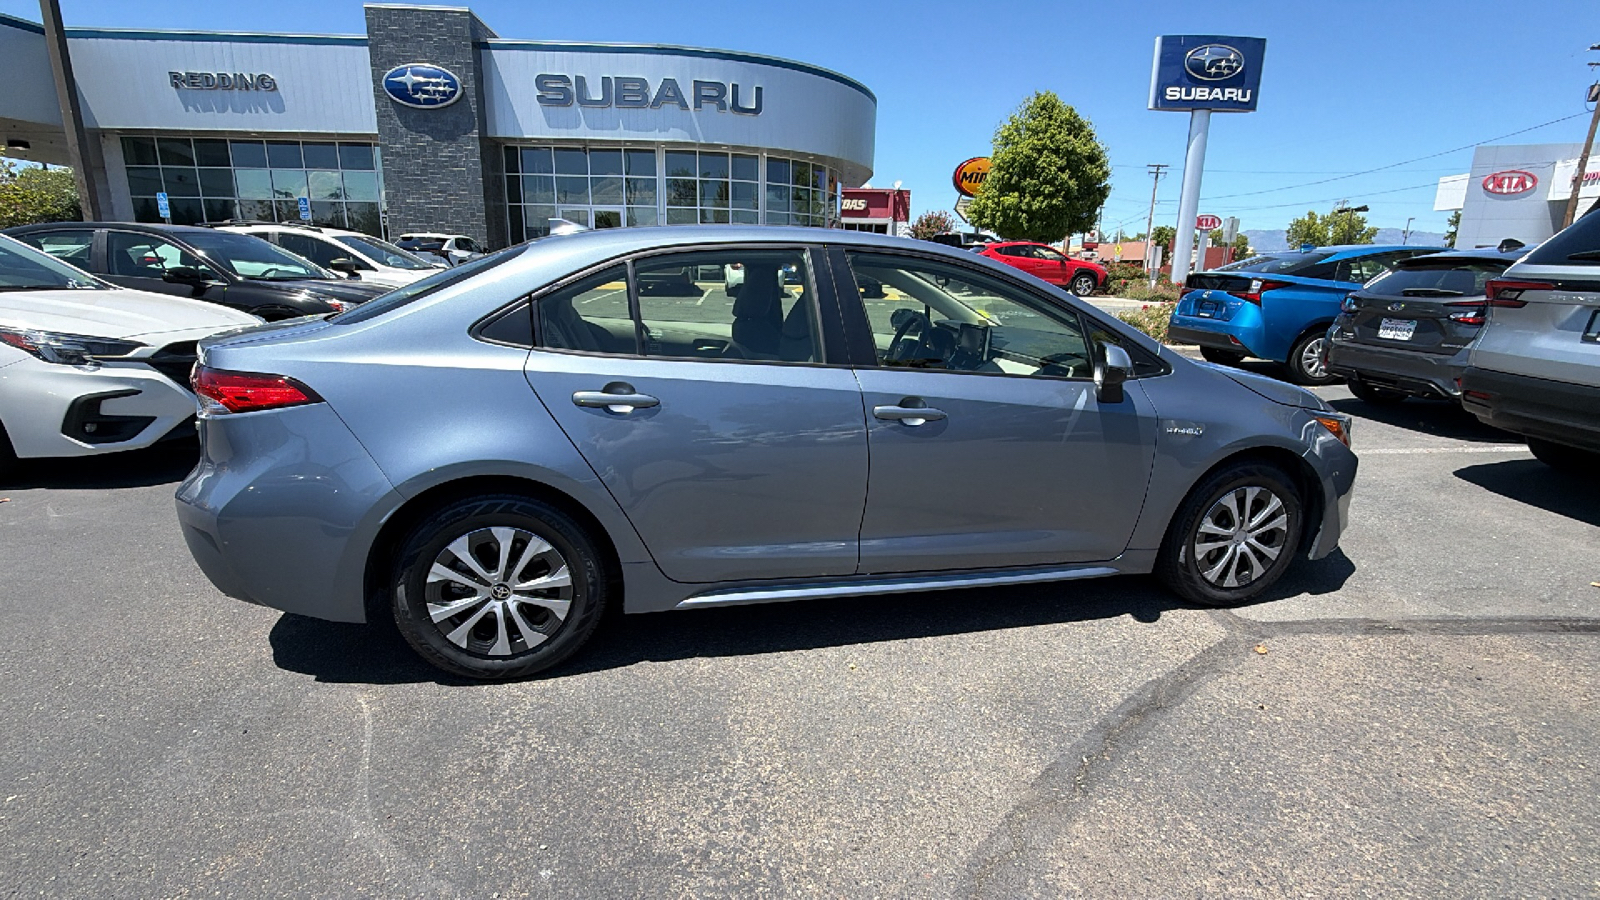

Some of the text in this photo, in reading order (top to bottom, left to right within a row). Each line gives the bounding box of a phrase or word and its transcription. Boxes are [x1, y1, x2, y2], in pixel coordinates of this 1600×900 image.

[168, 71, 278, 91] REDDING
[534, 73, 763, 116] SUBARU
[1165, 87, 1251, 102] SUBARU
[841, 198, 867, 210] DAS
